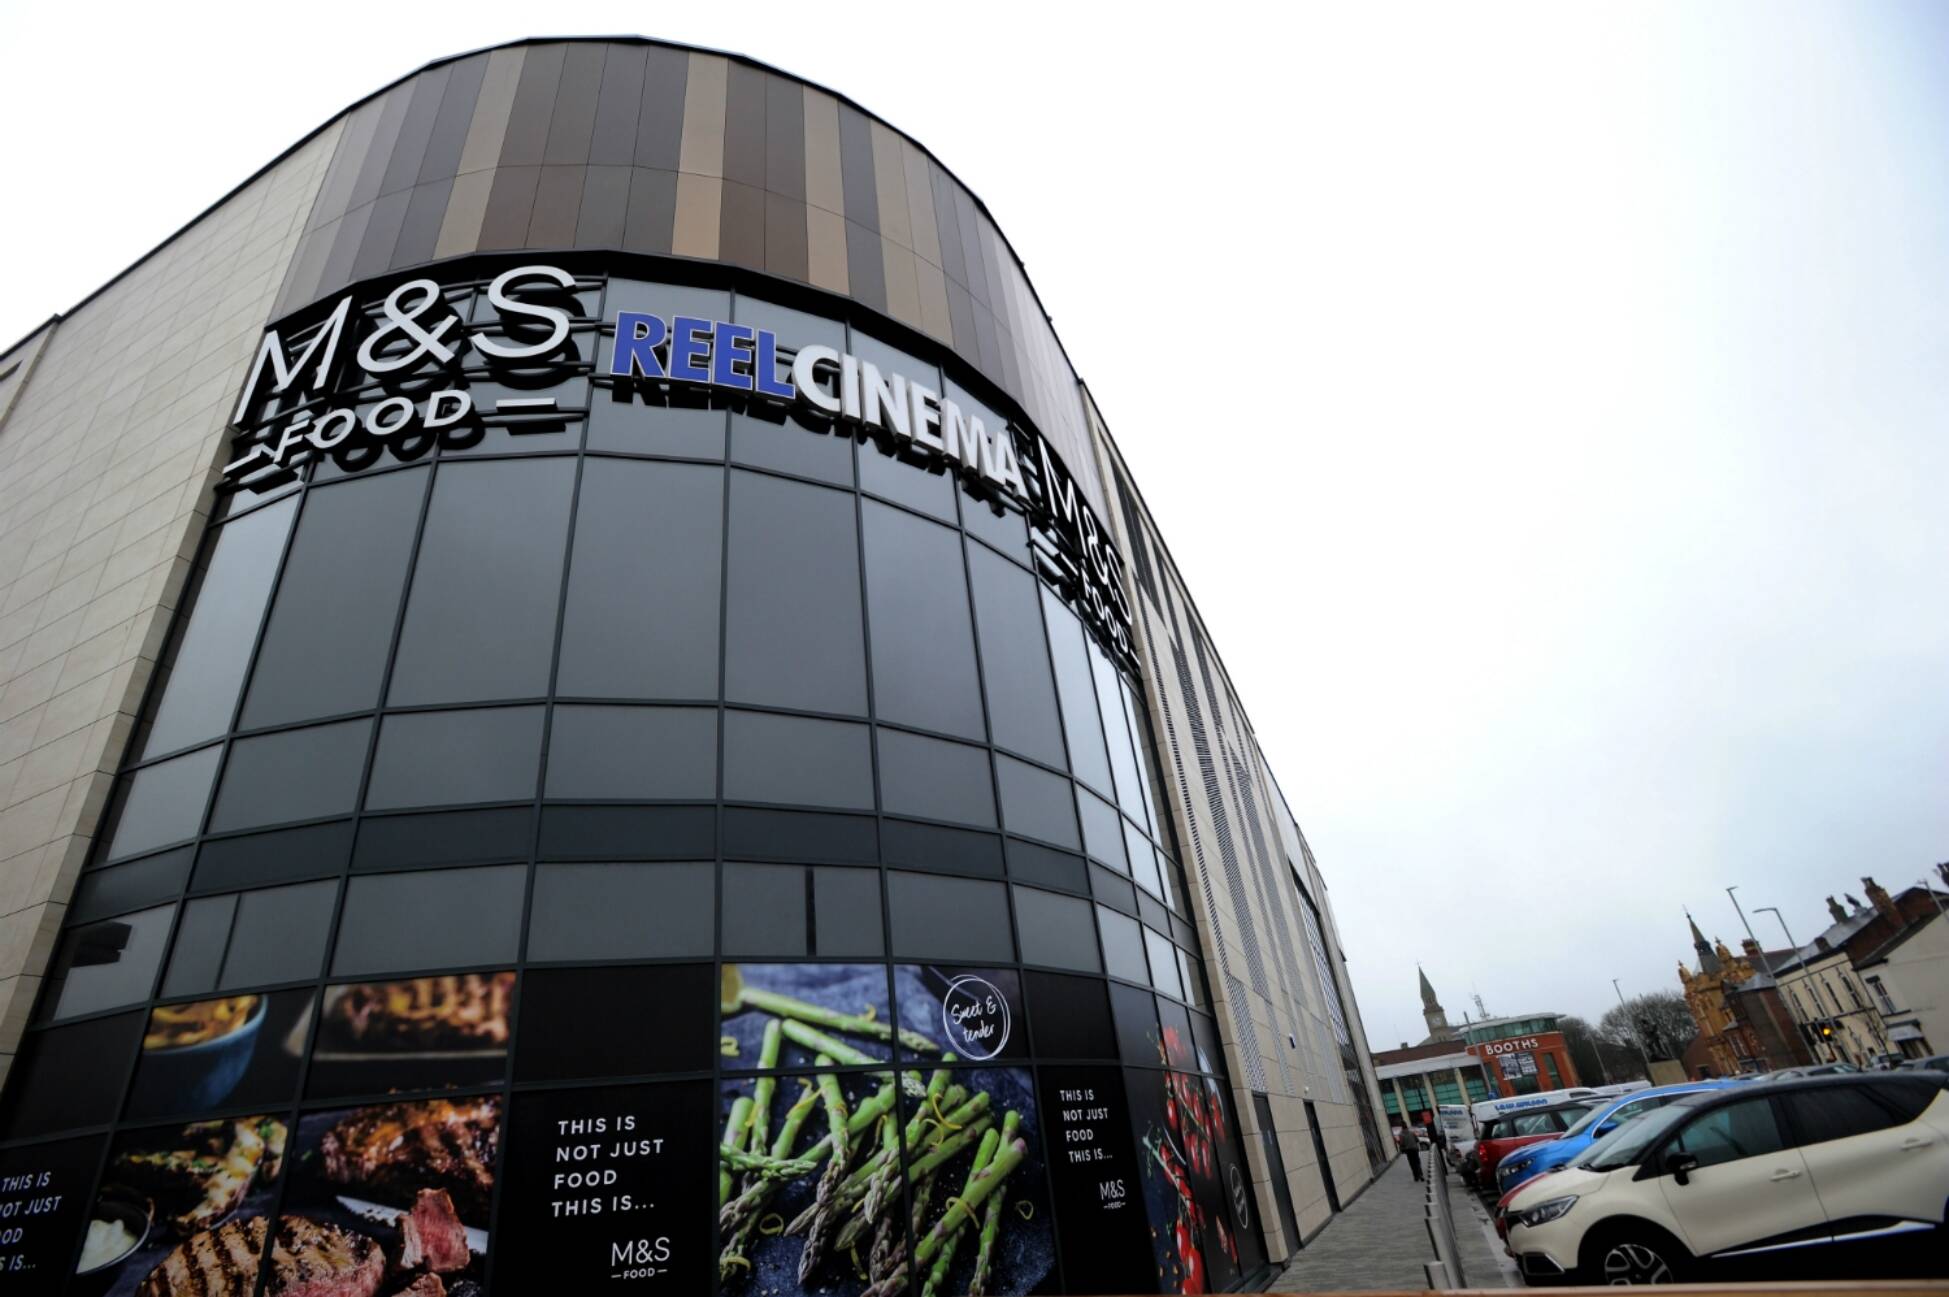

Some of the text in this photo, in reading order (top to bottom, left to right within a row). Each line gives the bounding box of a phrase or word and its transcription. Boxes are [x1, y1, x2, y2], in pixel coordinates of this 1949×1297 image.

[233, 265, 577, 425] M&S
[610, 310, 1030, 499] REEL CINEMA
[274, 389, 472, 463] FOOD
[1037, 434, 1133, 626] M&S
[1485, 1038, 1538, 1055] BOOTHS
[1060, 1089, 1095, 1101] THIS IS
[1063, 1108, 1108, 1121] NOT JUST
[558, 1116, 636, 1136] THIS IS
[1066, 1129, 1094, 1142] FOOD
[556, 1139, 664, 1162] NOT JUST
[1068, 1149, 1091, 1163] THIS
[2, 1171, 51, 1192] THIS IS
[554, 1169, 617, 1190] FOOD
[1099, 1179, 1125, 1200] M&S
[0, 1195, 62, 1218] OT JUST
[552, 1195, 655, 1217] THIS IS...
[611, 1237, 671, 1267] M&S
